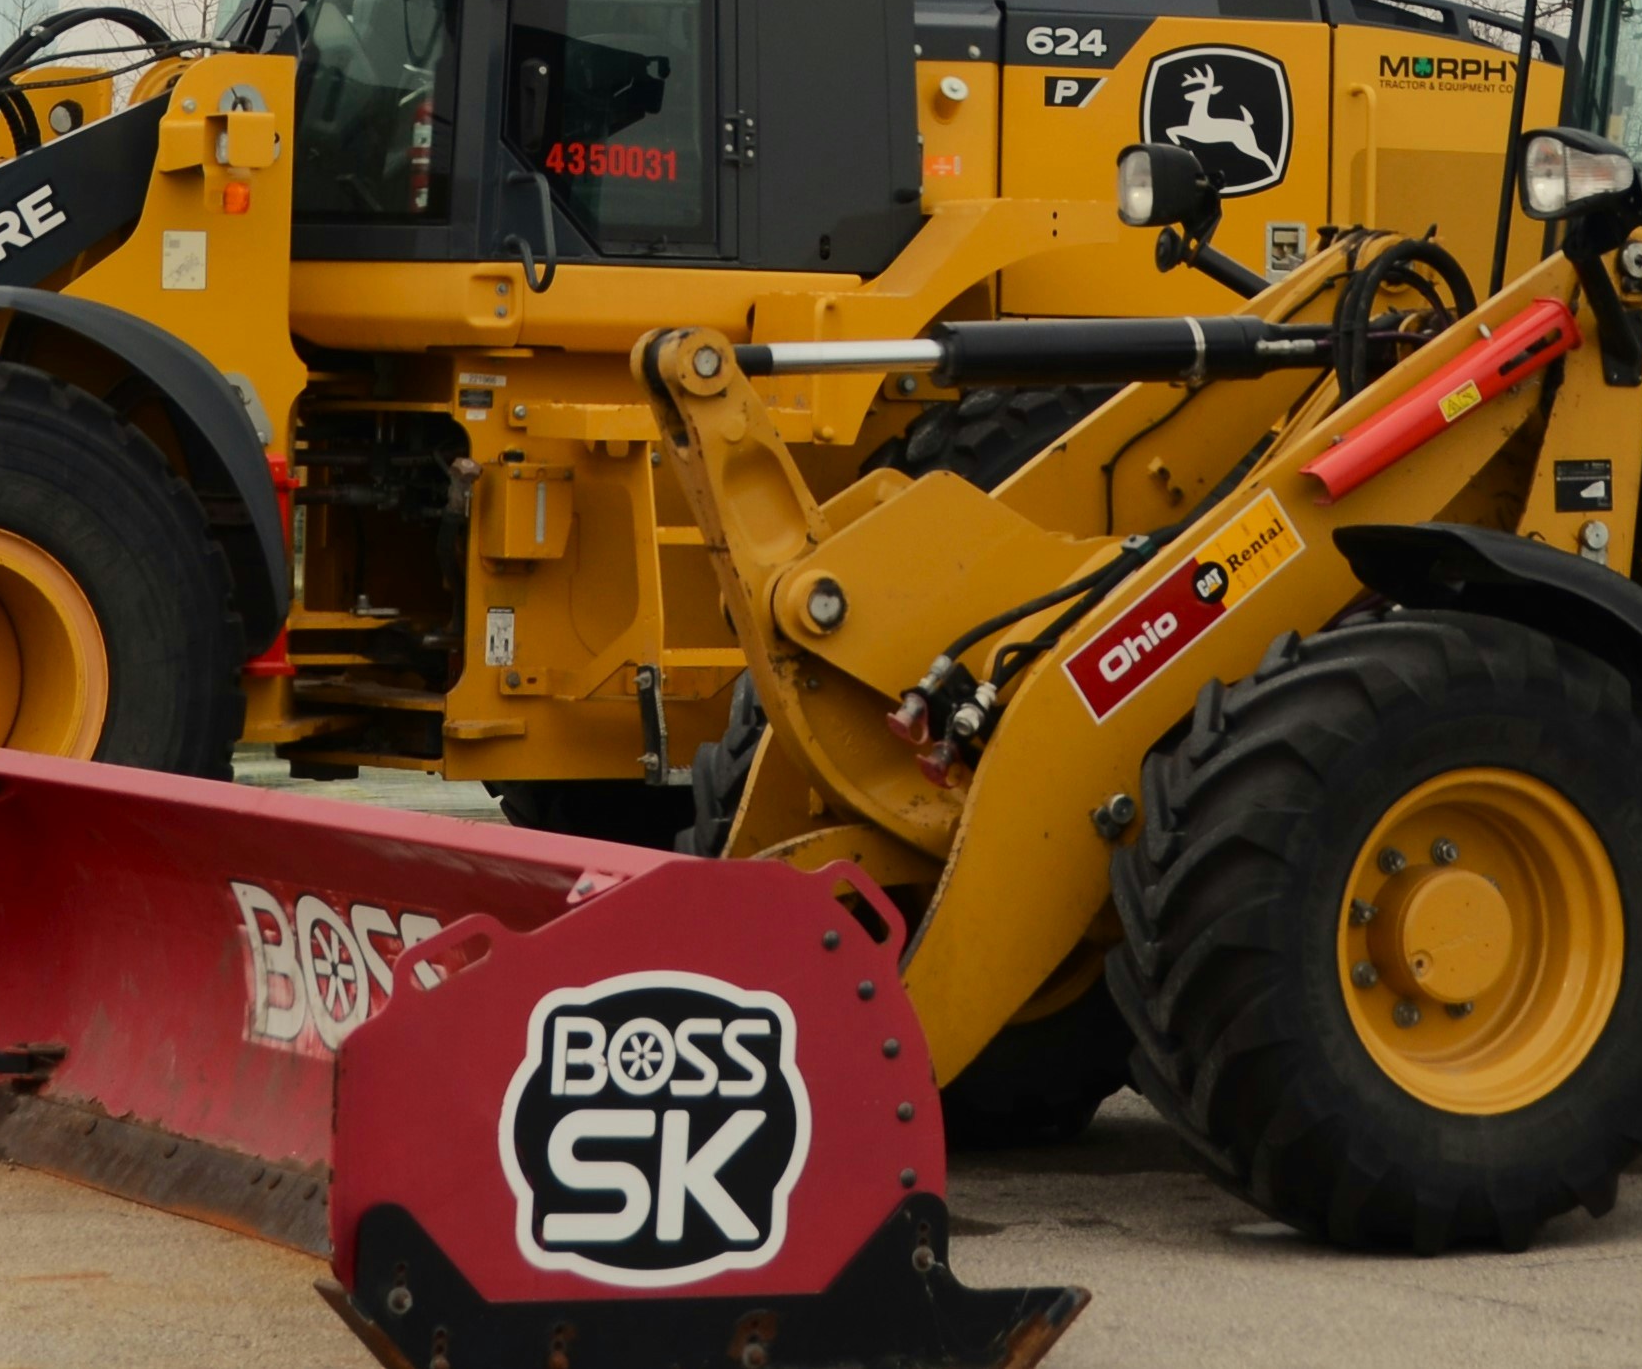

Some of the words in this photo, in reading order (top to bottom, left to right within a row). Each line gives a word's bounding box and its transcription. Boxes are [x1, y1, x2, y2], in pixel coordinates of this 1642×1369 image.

[1026, 26, 1107, 57] 624
[1054, 79, 1079, 104] P
[1379, 79, 1426, 91] TRACTOR
[1428, 81, 1435, 91] &
[1438, 81, 1496, 93] EQUIPMENT
[545, 142, 677, 181] 4350031
[1098, 612, 1178, 682] Ohio
[1196, 567, 1223, 598] CAT
[1226, 518, 1284, 573] Rental
[550, 1016, 771, 1097] BOSS
[543, 1109, 767, 1243] SK
